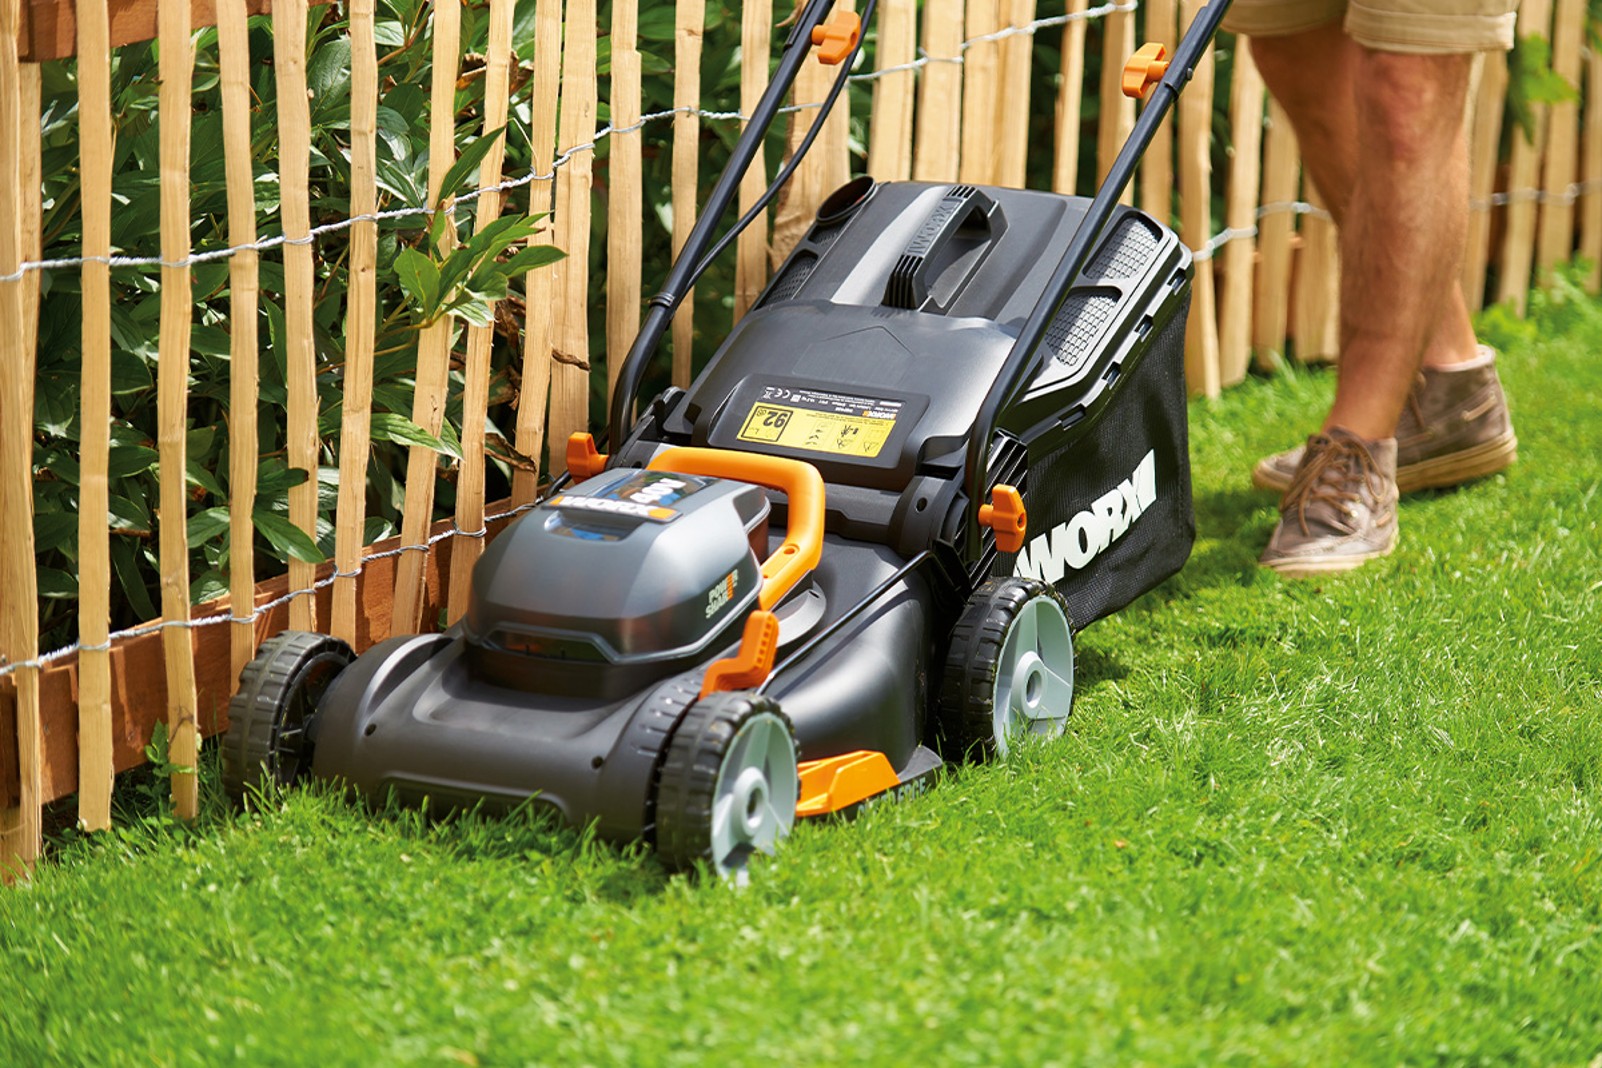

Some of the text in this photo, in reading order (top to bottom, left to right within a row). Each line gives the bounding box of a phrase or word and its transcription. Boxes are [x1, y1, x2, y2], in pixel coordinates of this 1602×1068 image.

[764, 411, 788, 428] 92
[558, 495, 653, 517] WORX
[1013, 449, 1156, 584] WORX
[708, 569, 739, 603] POWER
